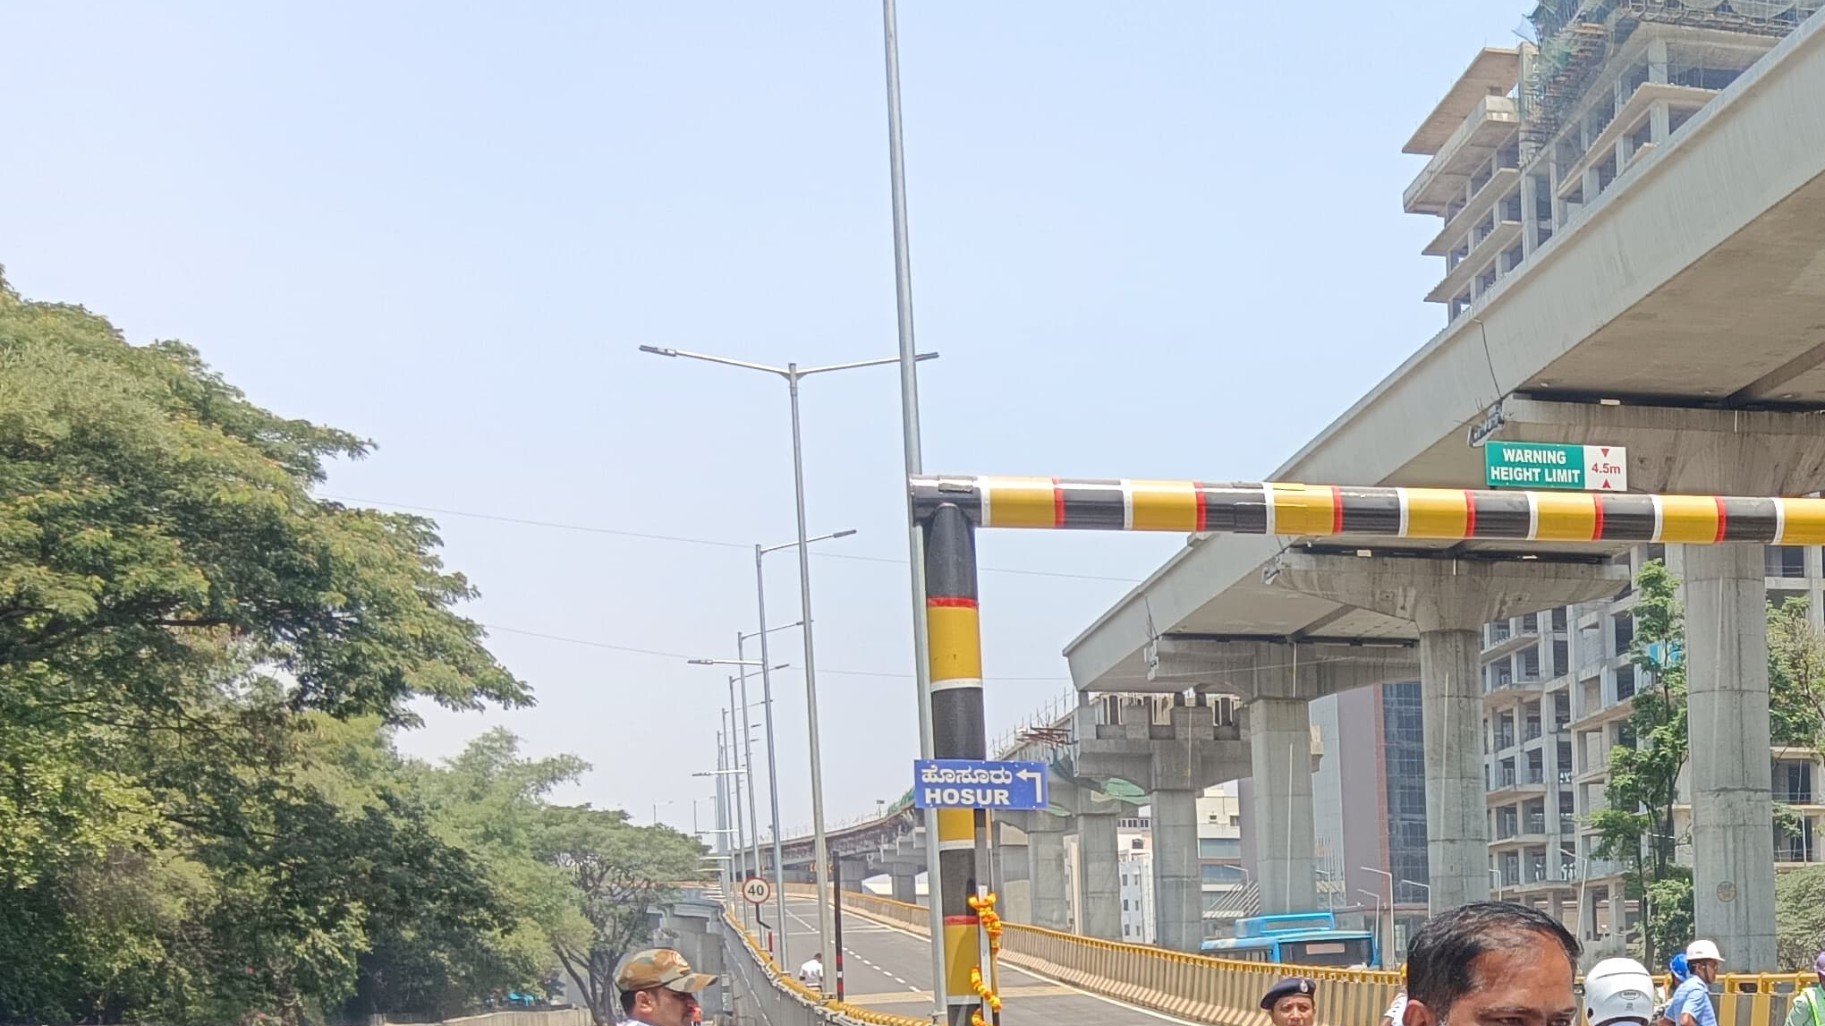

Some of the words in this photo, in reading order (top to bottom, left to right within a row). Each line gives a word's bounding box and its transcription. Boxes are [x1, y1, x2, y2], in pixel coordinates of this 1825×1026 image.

[1502, 448, 1566, 464] WARNING
[1490, 466, 1541, 482] HEIGHT
[1544, 469, 1580, 483] LIMIT
[1591, 463, 1621, 475] 4.5m
[921, 764, 1013, 785] ಹೊಸೂರು
[925, 788, 1010, 805] HOSUR
[748, 884, 765, 896] 40
